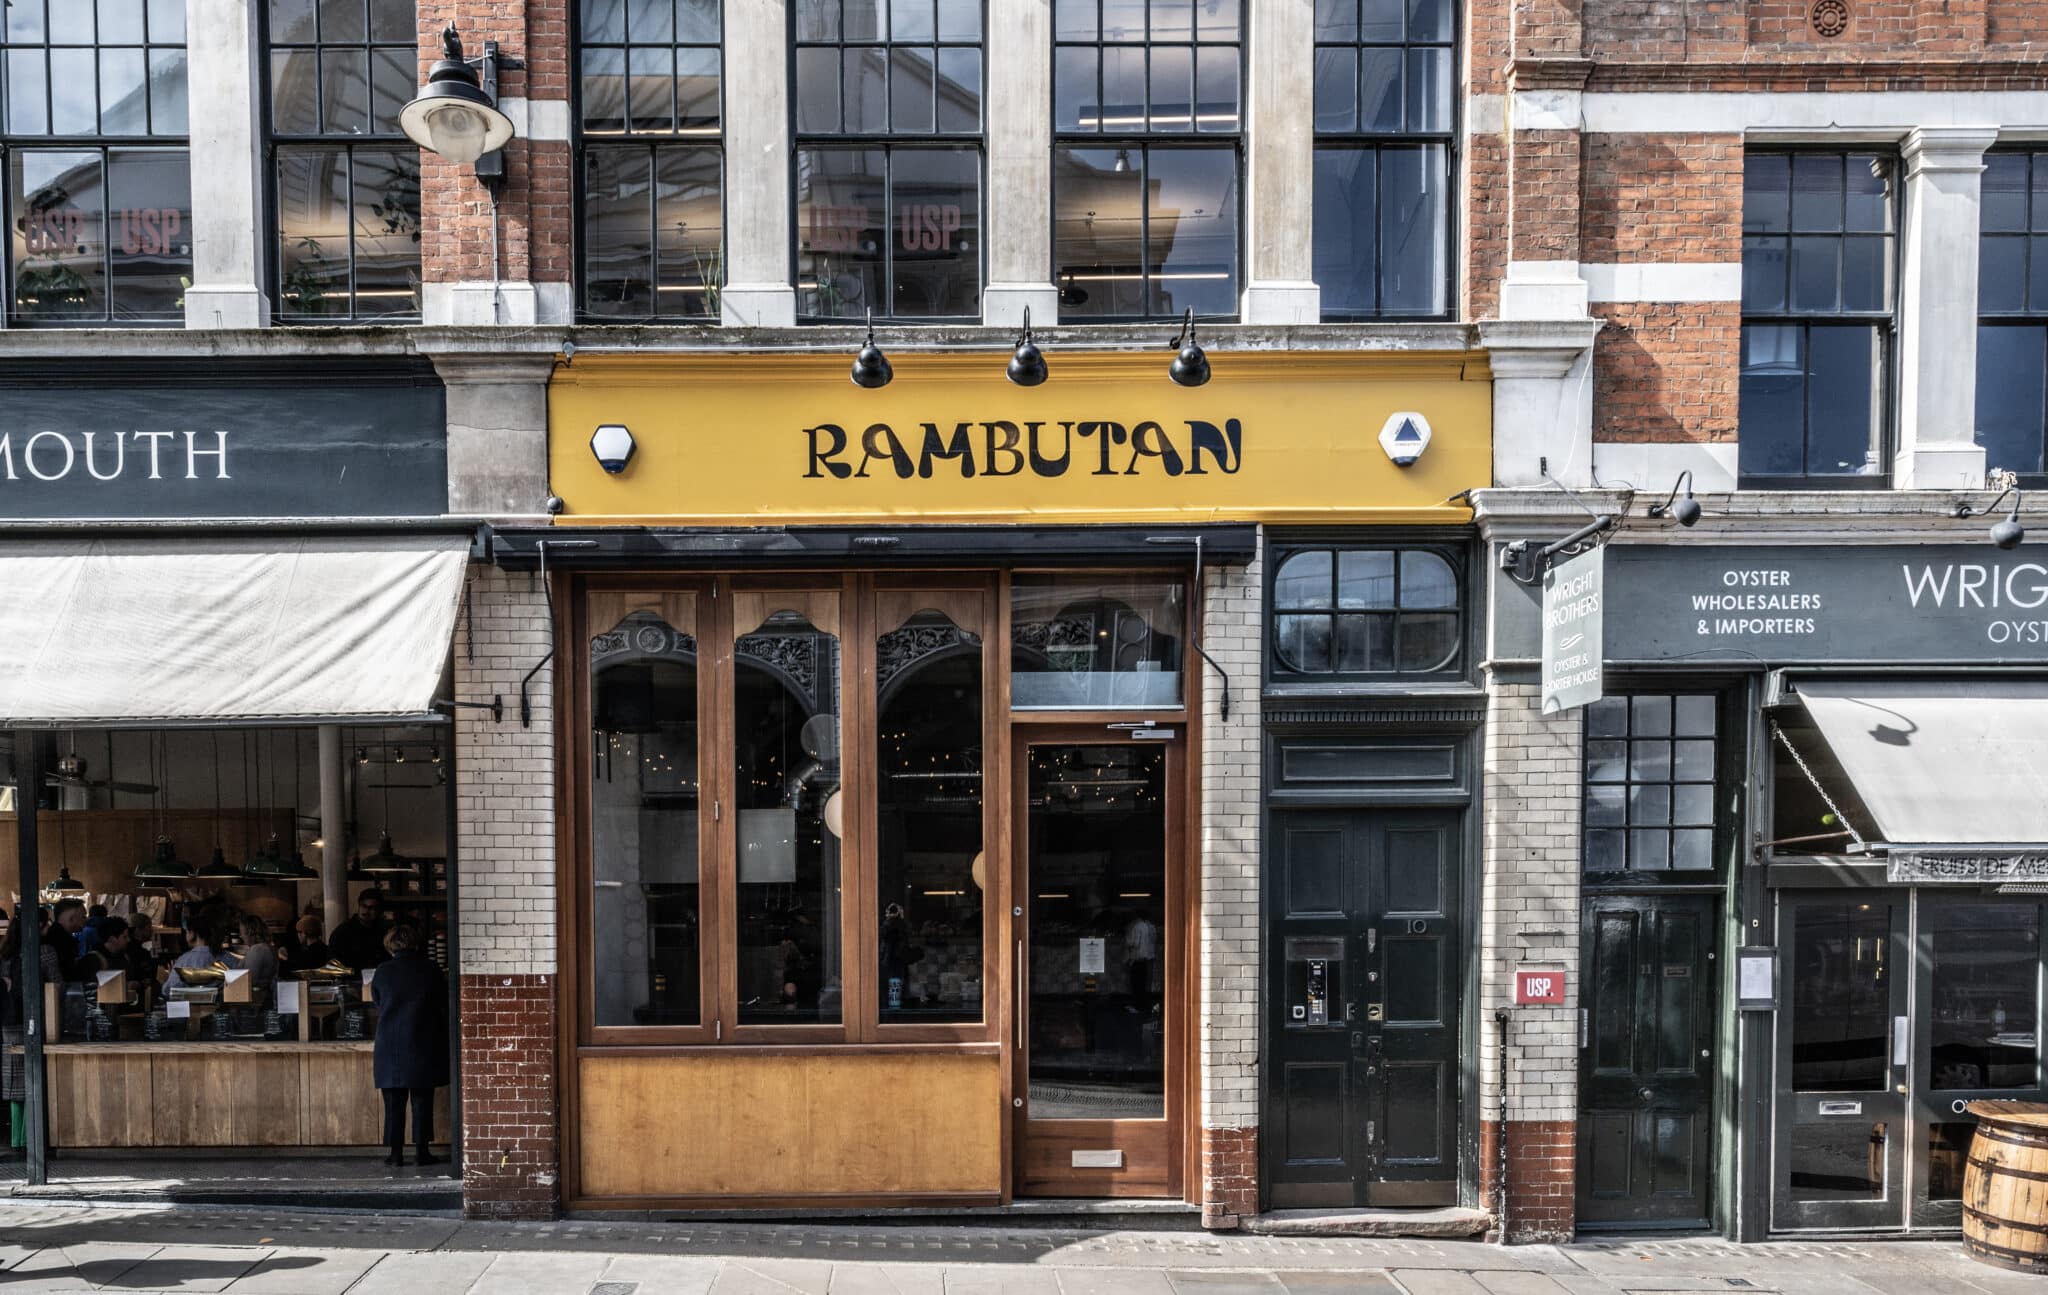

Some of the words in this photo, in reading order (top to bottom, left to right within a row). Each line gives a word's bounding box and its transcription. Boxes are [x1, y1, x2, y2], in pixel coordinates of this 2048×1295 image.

[802, 418, 1242, 479] RAMBUTAN
[1552, 570, 1594, 604] WRIGHT
[1723, 570, 1791, 586] OYSTER
[1903, 563, 2048, 608] WRIG
[1544, 592, 1599, 630] BROTHERS
[1692, 594, 1821, 610] WHOLESALERS
[1697, 619, 1710, 634] &
[1715, 618, 1816, 634] IMPORTERS
[1554, 655, 1581, 673] OYSTER
[1573, 667, 1598, 687] HOUSE
[1985, 857, 2009, 874] DE
[2017, 857, 2048, 874] ME
[1407, 919, 1427, 934] 10
[1526, 977, 1554, 998] USP.
